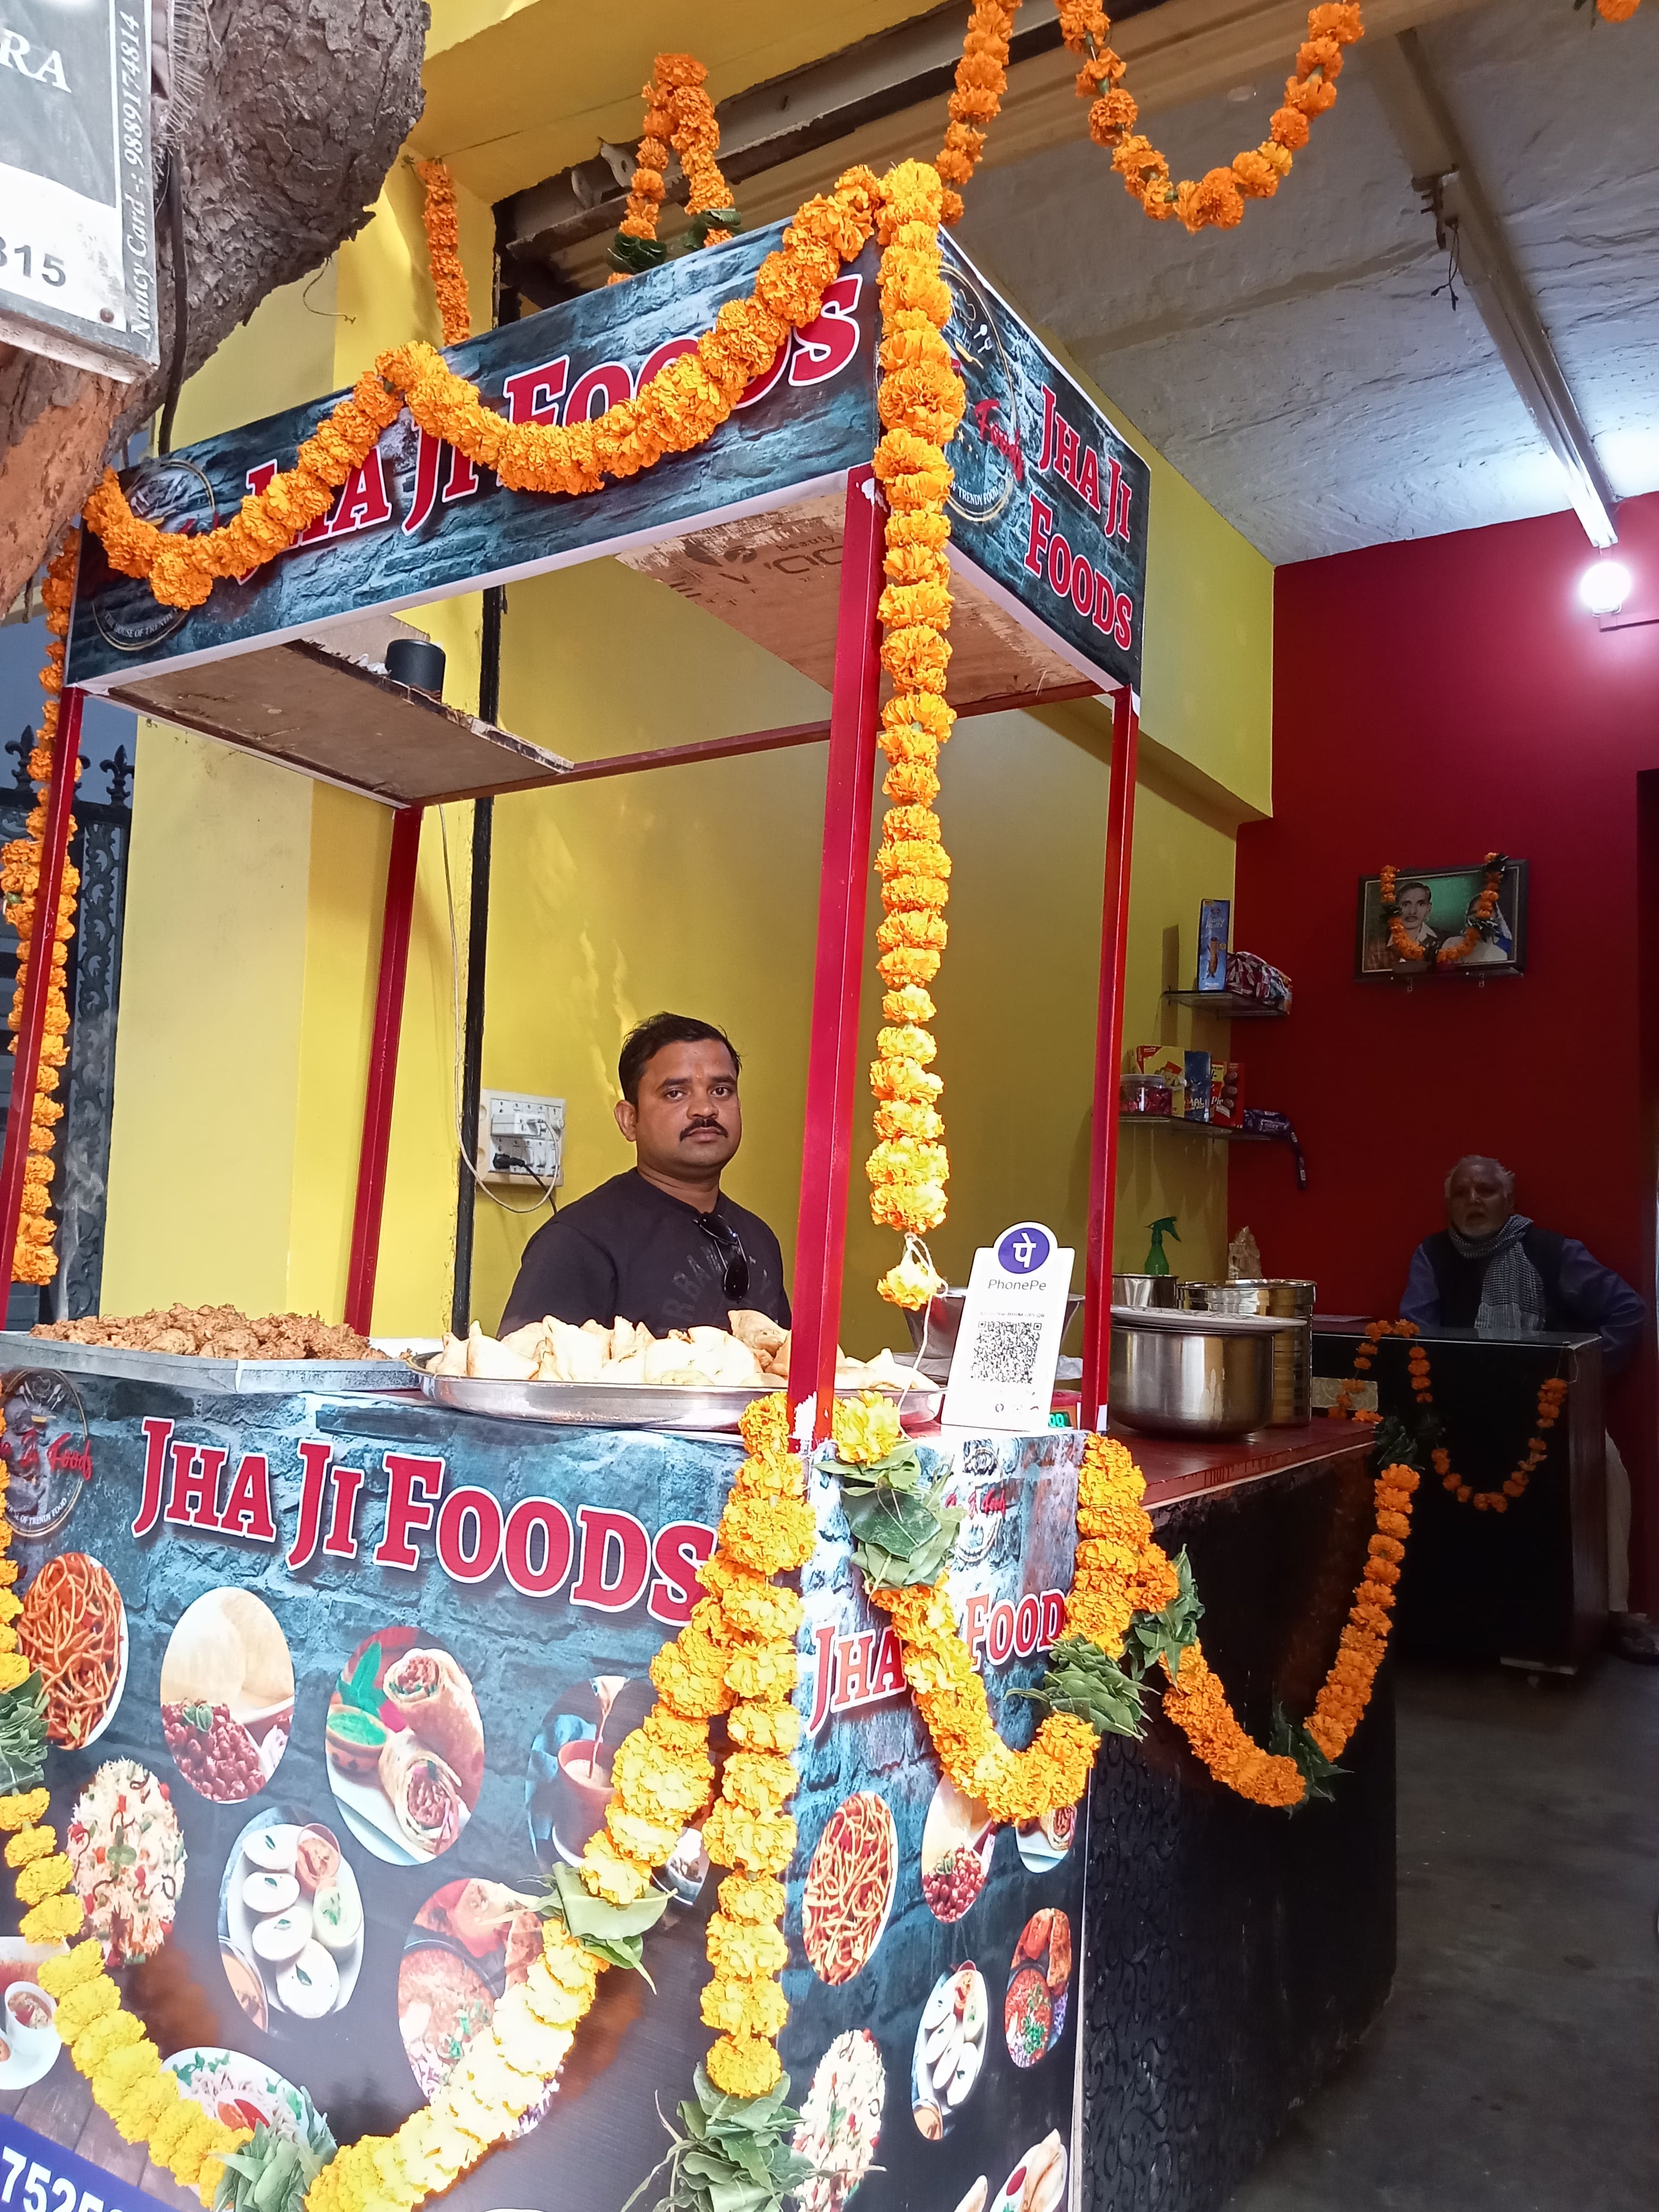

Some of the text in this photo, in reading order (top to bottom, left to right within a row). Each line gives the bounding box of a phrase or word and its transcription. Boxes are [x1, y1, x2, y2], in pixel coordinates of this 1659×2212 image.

[119, 11, 145, 170] 9889174814
[124, 192, 147, 258] Card
[131, 263, 154, 341] Nancy
[497, 273, 863, 486] FOS
[958, 485, 983, 506] TRENDY
[983, 485, 999, 505] FOOD
[1037, 382, 1132, 543] JHA JI
[775, 533, 835, 552] beauty
[1024, 491, 1133, 651] FOODS
[987, 1278, 1047, 1292] PhonePe
[1012, 1231, 1037, 1269] पे
[51, 1497, 68, 1517] FOOD
[131, 1416, 719, 1627] JHA JI FOODS
[806, 1588, 1068, 1739] JHA FOOD
[1, 2145, 125, 2212] 752
